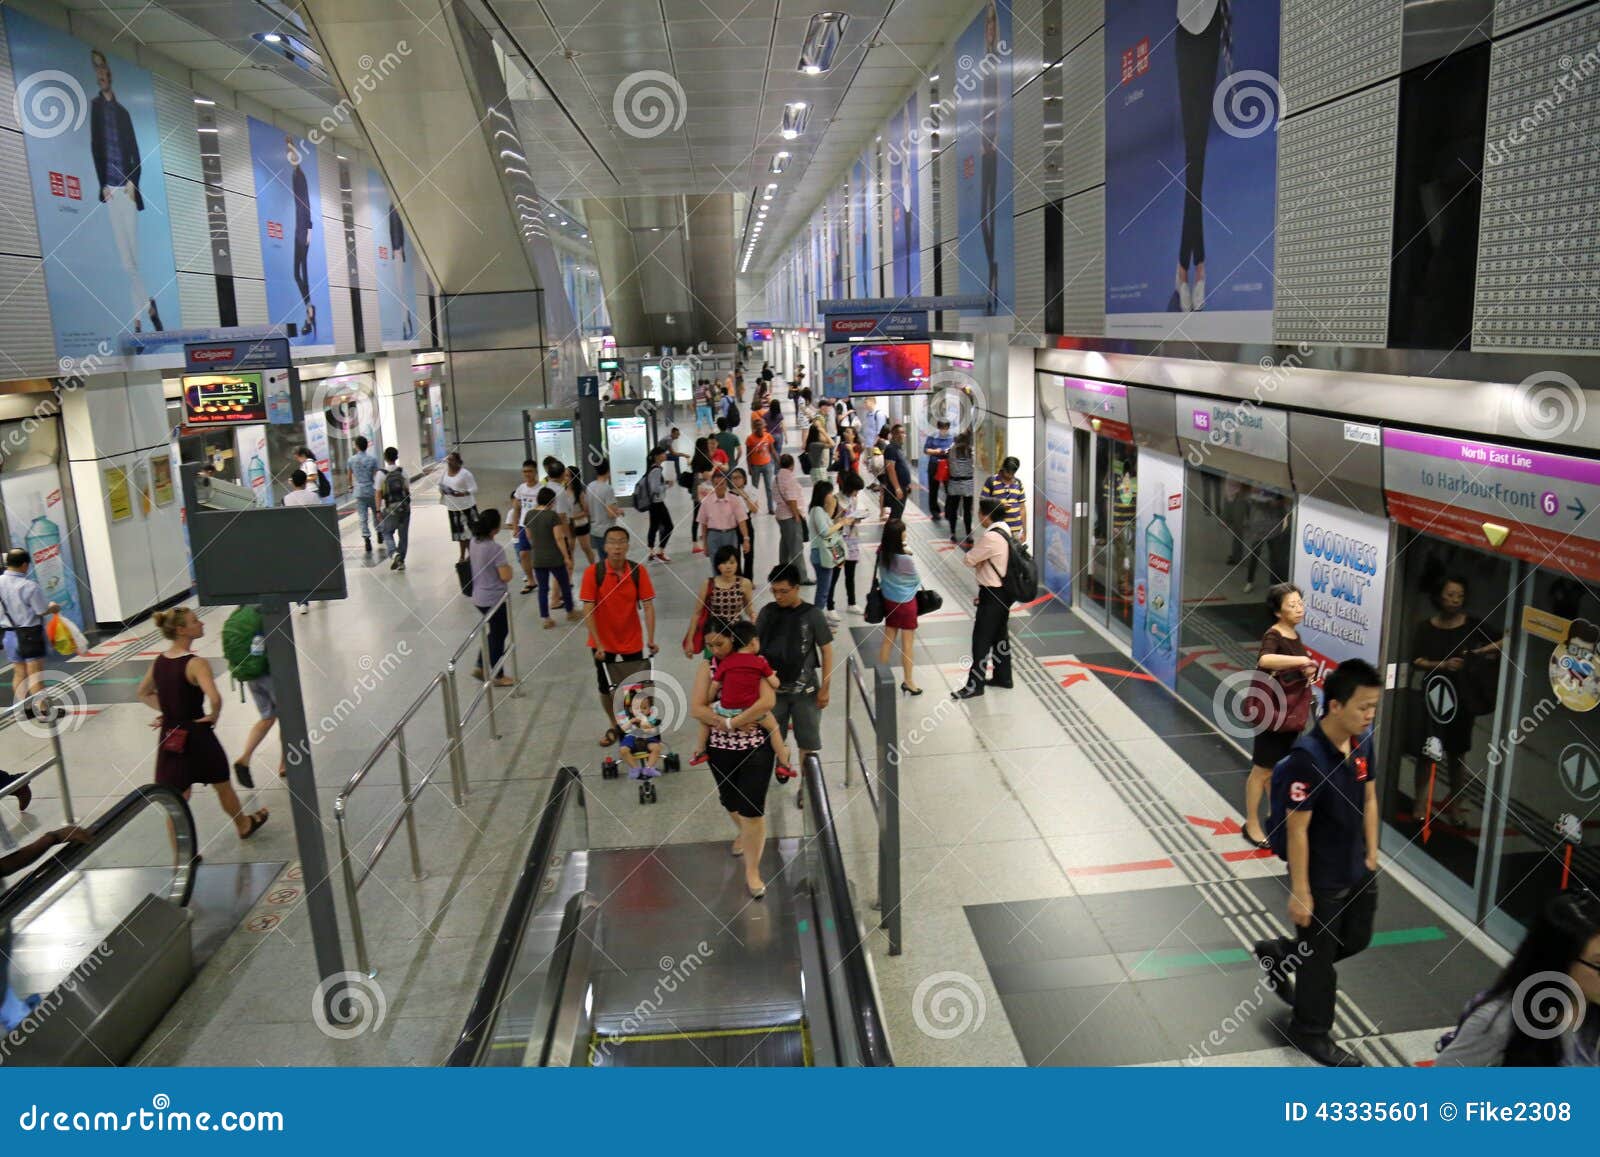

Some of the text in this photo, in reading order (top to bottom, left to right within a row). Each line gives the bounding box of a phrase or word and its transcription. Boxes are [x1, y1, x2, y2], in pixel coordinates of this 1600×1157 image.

[834, 320, 874, 331] Colgate
[1461, 446, 1533, 468] North East Line
[1421, 469, 1434, 487] to
[1437, 472, 1536, 510] HarbourFront
[1303, 523, 1378, 576] GOODNESS
[1310, 560, 1330, 594] OF
[1304, 612, 1366, 646] fresh breath
[1311, 594, 1370, 631] long lasting
